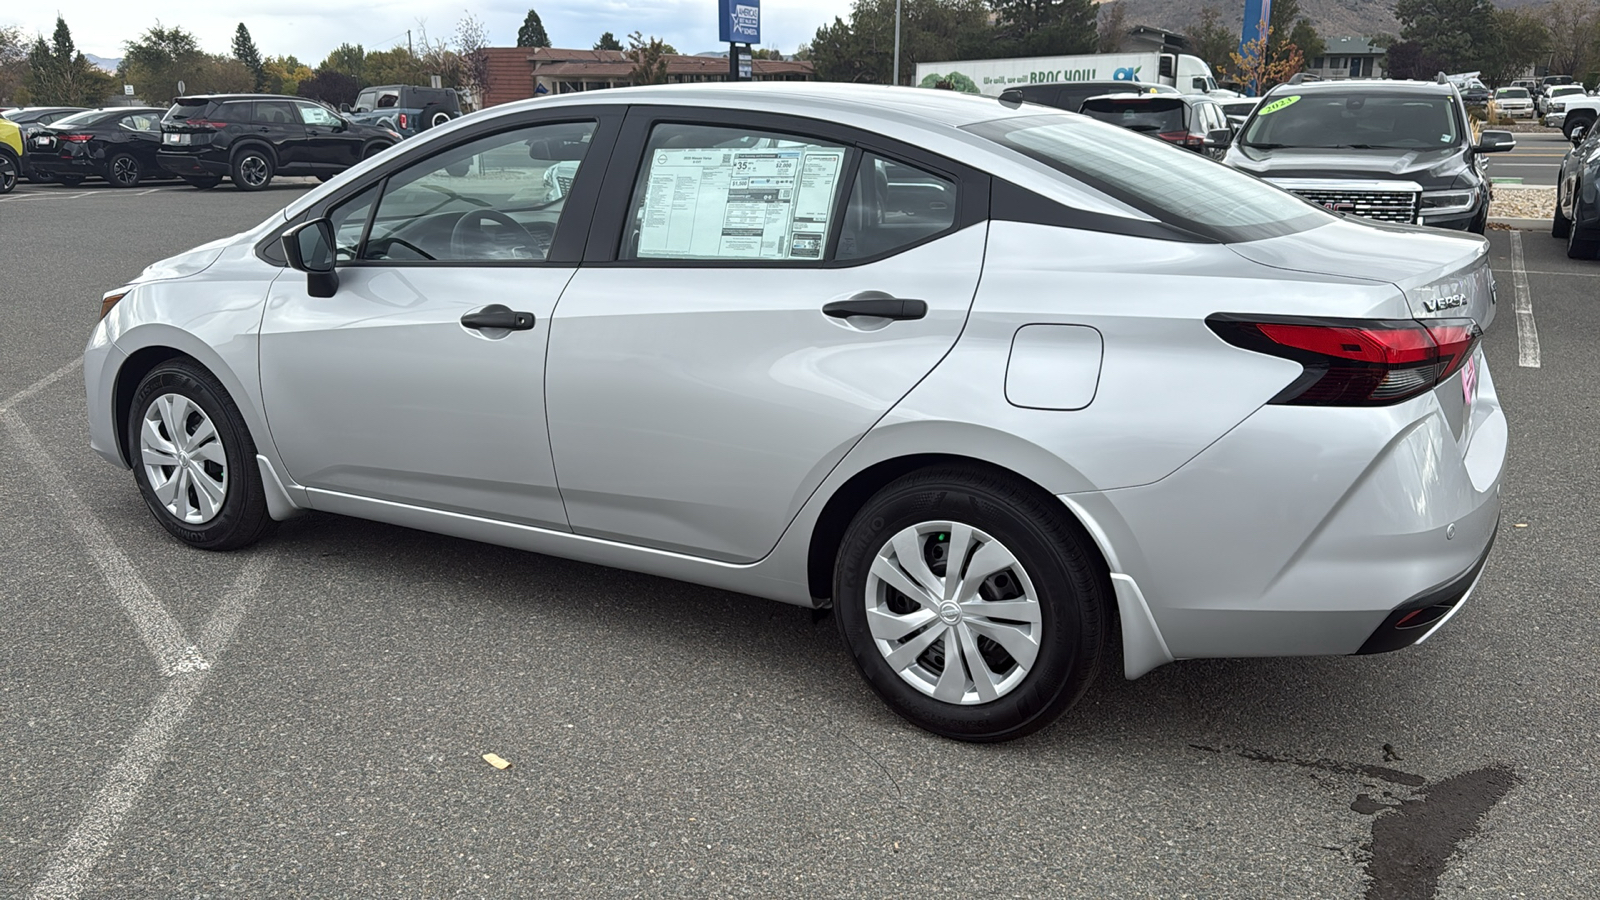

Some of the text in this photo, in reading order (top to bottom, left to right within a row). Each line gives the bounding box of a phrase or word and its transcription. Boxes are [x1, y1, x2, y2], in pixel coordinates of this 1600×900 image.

[983, 77, 993, 85] We
[993, 76, 1006, 85] will,
[1016, 75, 1028, 83] will
[737, 161, 748, 170] 35
[1423, 293, 1468, 313] VERSA
